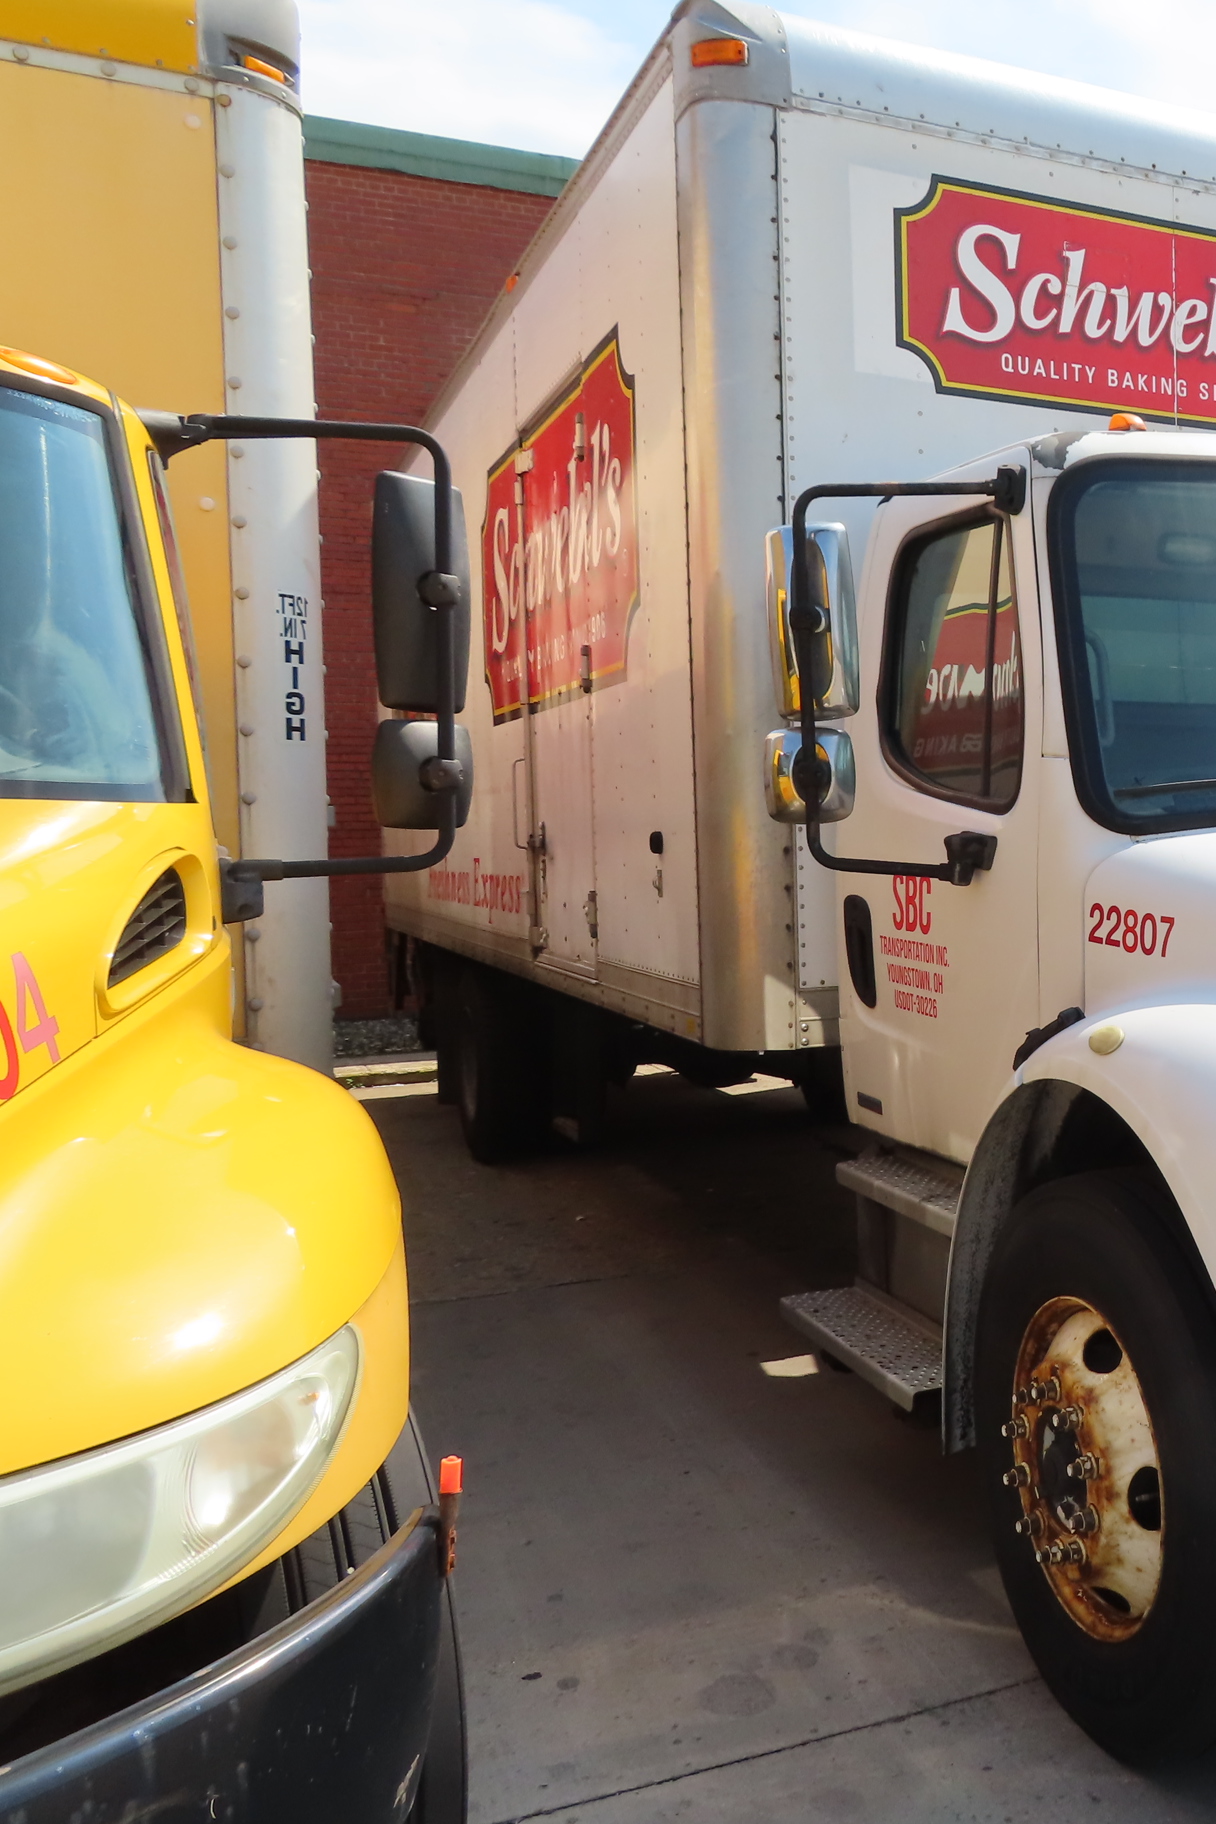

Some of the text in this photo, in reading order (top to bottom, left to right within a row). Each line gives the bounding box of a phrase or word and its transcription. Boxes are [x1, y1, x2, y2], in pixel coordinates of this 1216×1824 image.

[1001, 353, 1096, 384] QUALITY
[1107, 369, 1187, 398] BAKING
[473, 857, 522, 924] Express
[892, 874, 932, 935] SBC
[879, 935, 950, 968] TRANSPORTATION INC.
[1088, 903, 1175, 957] 22807
[886, 962, 944, 994] YOUNGSTOWN, OH
